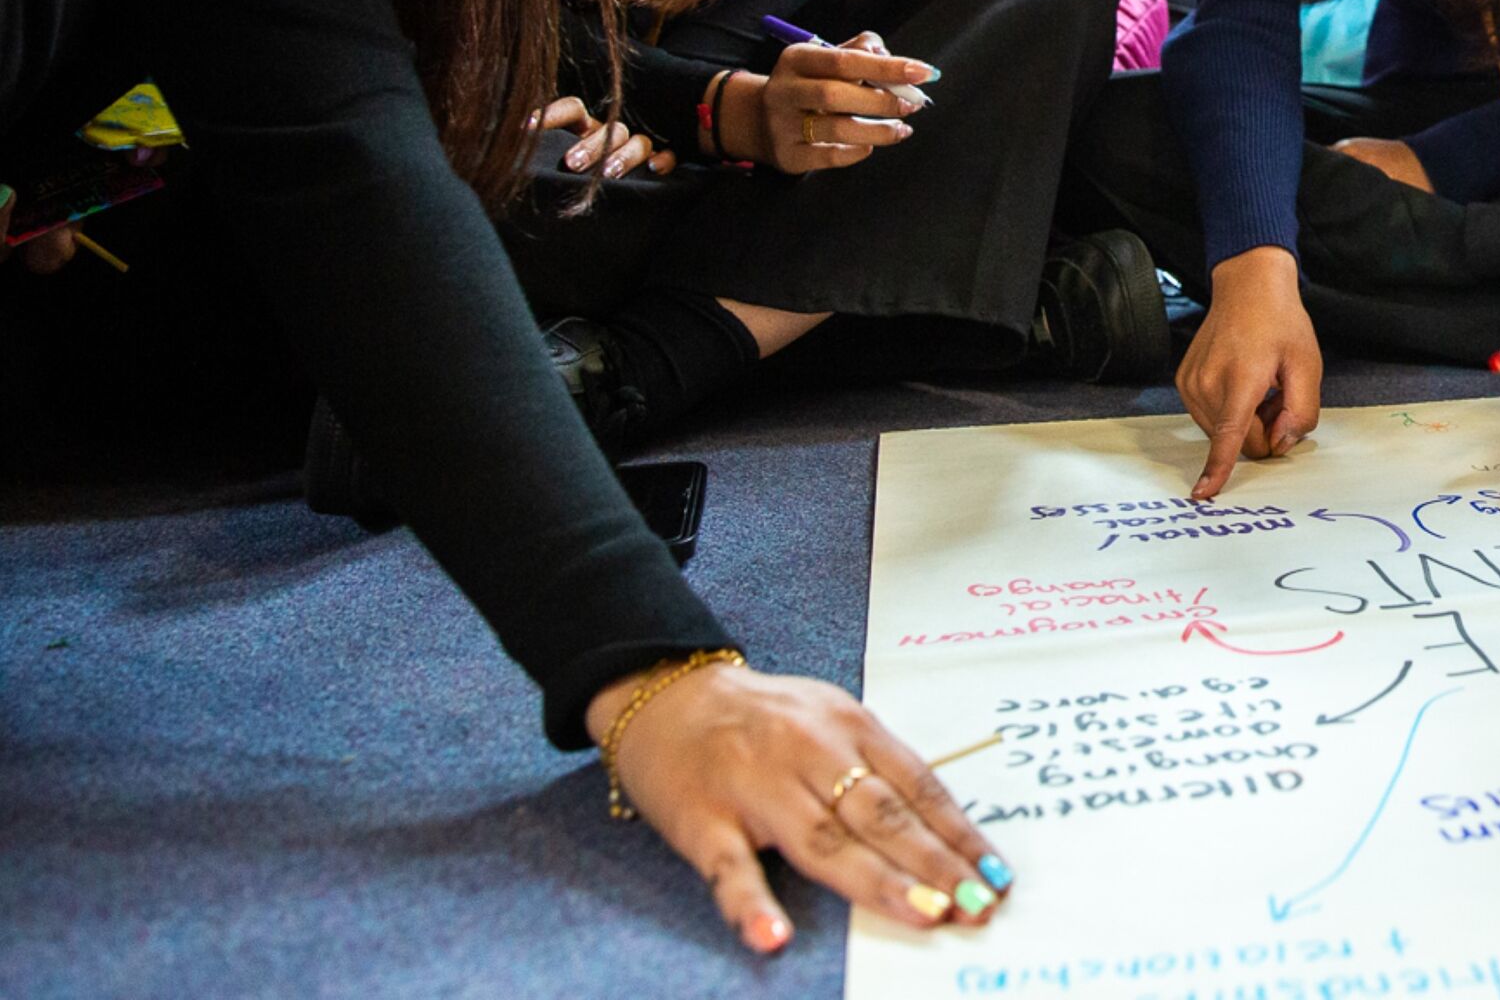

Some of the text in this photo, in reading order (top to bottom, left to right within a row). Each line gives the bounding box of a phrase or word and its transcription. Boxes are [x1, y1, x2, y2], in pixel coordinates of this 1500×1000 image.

[1093, 504, 1288, 530] physical
[1005, 720, 1281, 768] domestic
[1037, 743, 1319, 788] changing
